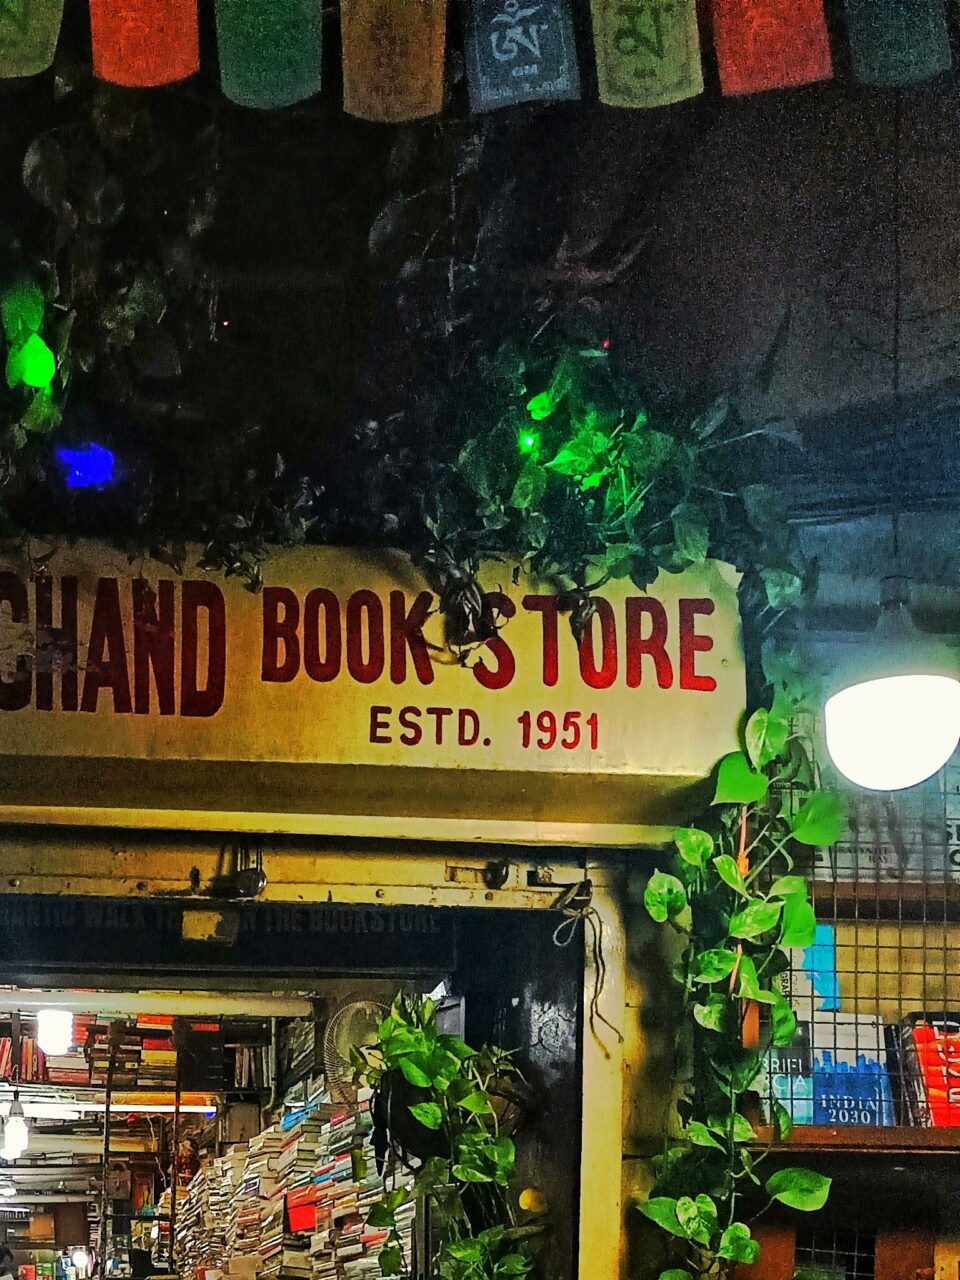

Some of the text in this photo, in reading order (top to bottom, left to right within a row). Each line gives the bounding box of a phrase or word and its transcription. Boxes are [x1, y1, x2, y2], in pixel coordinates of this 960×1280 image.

[261, 587, 435, 685] BOOK
[471, 585, 717, 692] STORE
[369, 705, 598, 750] ESTD. 1951
[308, 907, 441, 936] BOOKSTORE
[821, 1093, 878, 1112] INDIA
[827, 1108, 872, 1124] 2030
